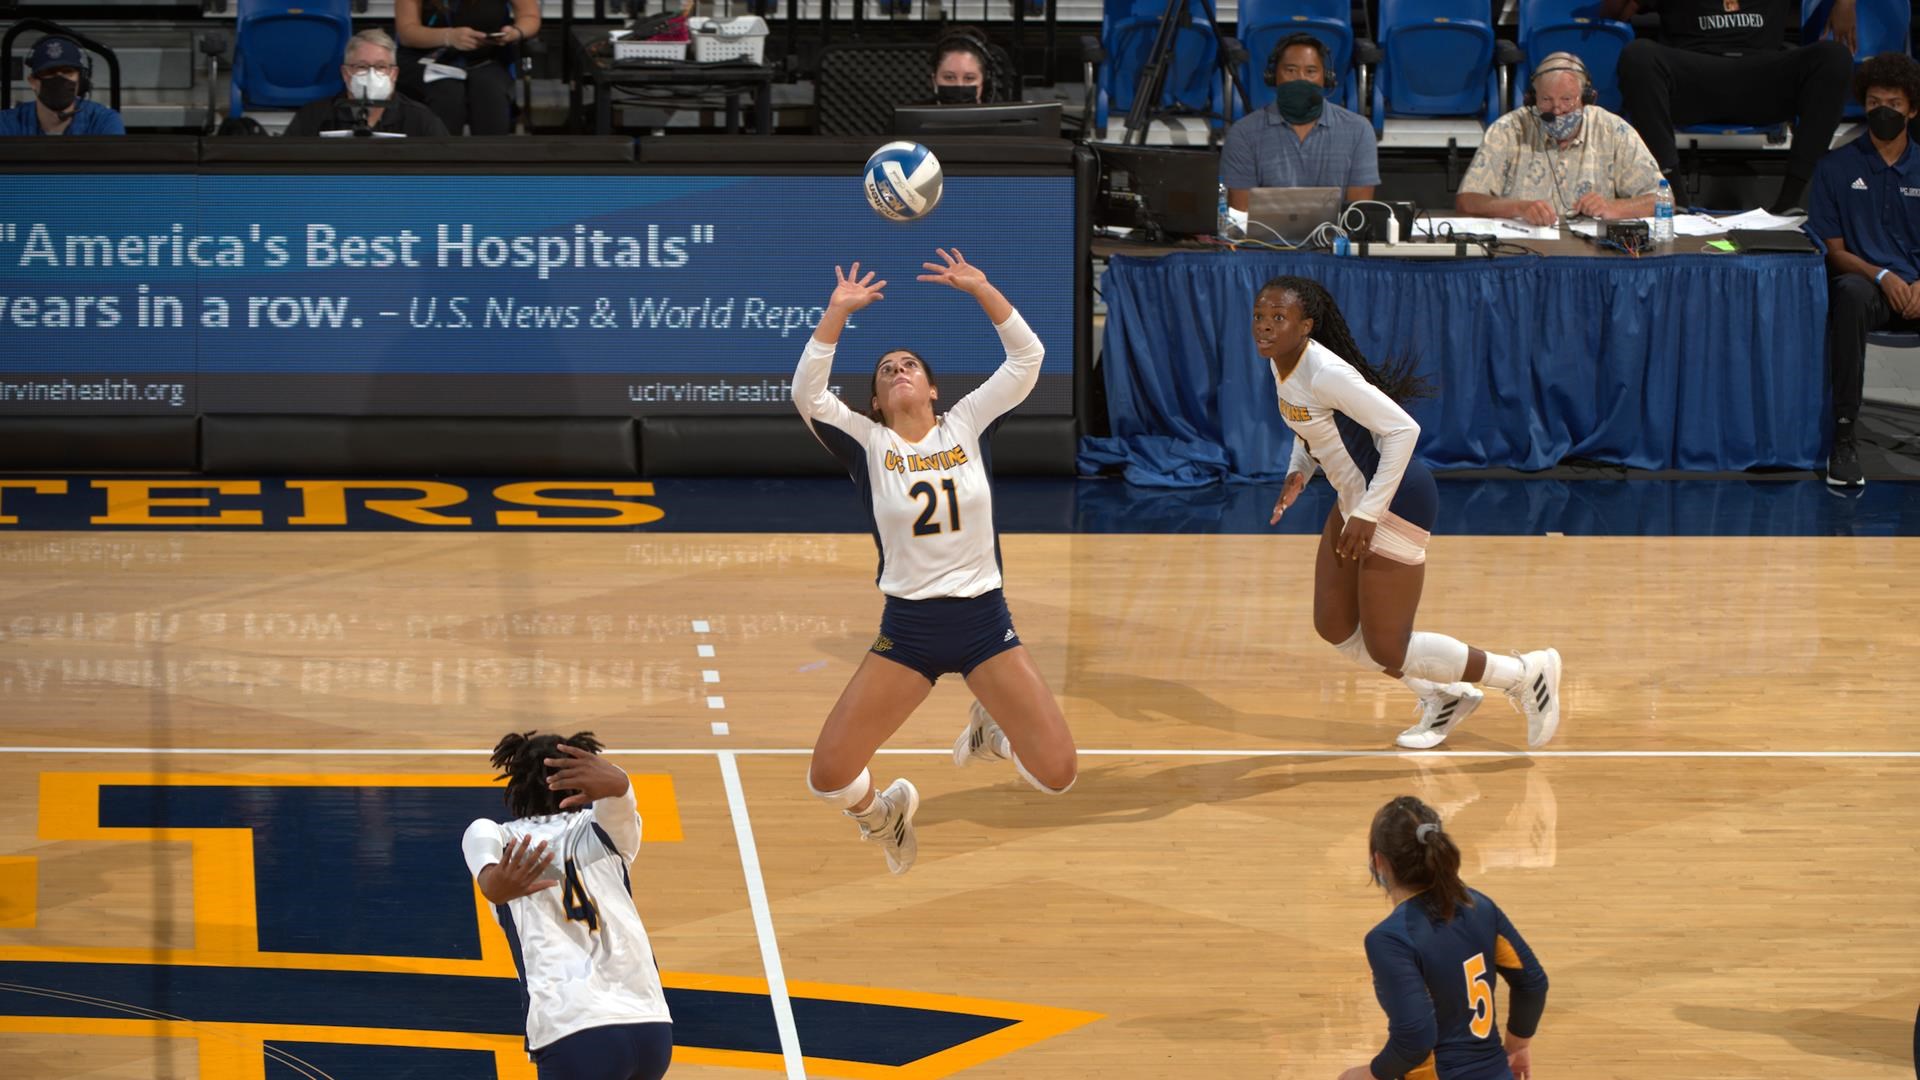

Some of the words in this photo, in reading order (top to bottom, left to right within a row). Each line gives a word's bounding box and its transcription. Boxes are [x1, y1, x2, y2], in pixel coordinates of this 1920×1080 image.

[1699, 13, 1764, 30] UNDIVIDED
[306, 223, 421, 267] Best
[436, 223, 715, 280] Hospitals"
[138, 284, 184, 328] in
[201, 296, 230, 328] a
[248, 296, 363, 328] row.
[408, 297, 474, 329] U.S.
[482, 297, 581, 329] News
[589, 297, 618, 329] &
[627, 297, 734, 329] World
[741, 297, 858, 338] Repo
[908, 478, 963, 538] 21
[562, 858, 598, 933] 4
[1463, 952, 1494, 1039] 5
